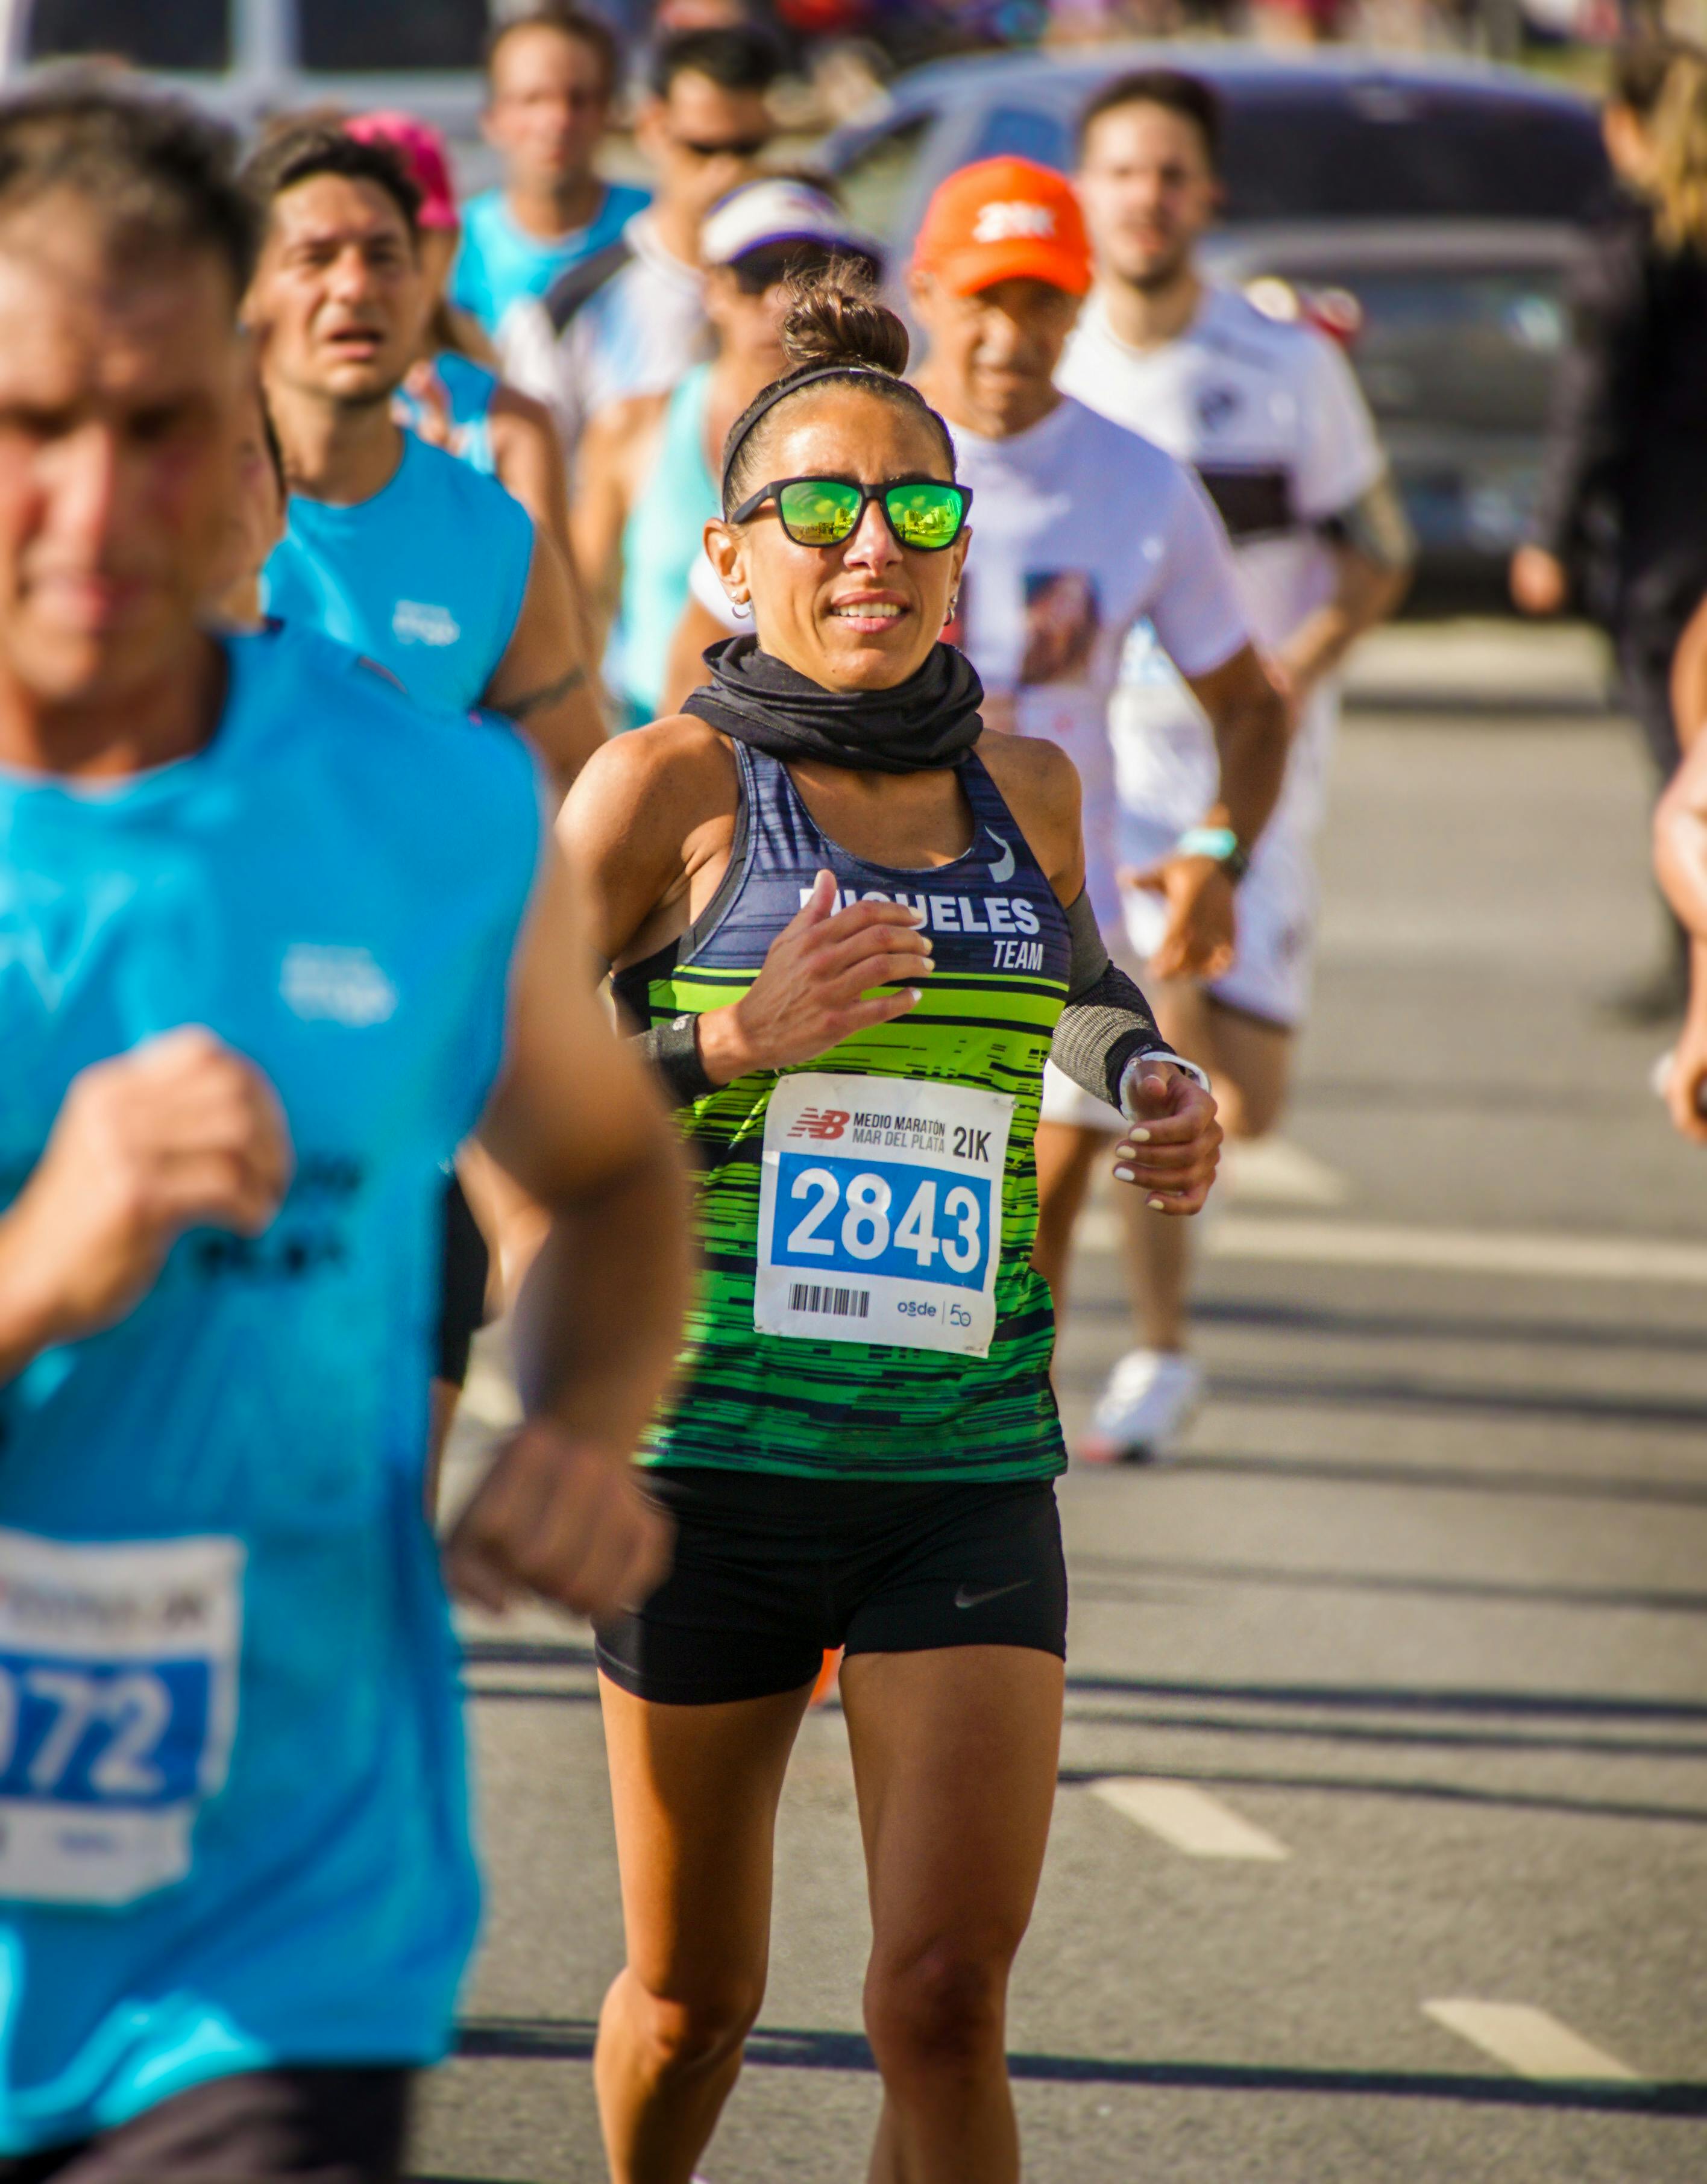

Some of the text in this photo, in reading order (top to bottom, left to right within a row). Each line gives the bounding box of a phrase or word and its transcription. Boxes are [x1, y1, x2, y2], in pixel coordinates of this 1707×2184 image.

[799, 888, 1040, 935] UELES
[993, 940, 1044, 971] TEAM
[853, 1112, 945, 1137] MEDIO MARATÓN
[852, 1128, 945, 1153] MAR DEL PLATA
[787, 1167, 981, 1273] 2843
[898, 1301, 936, 1317] osde
